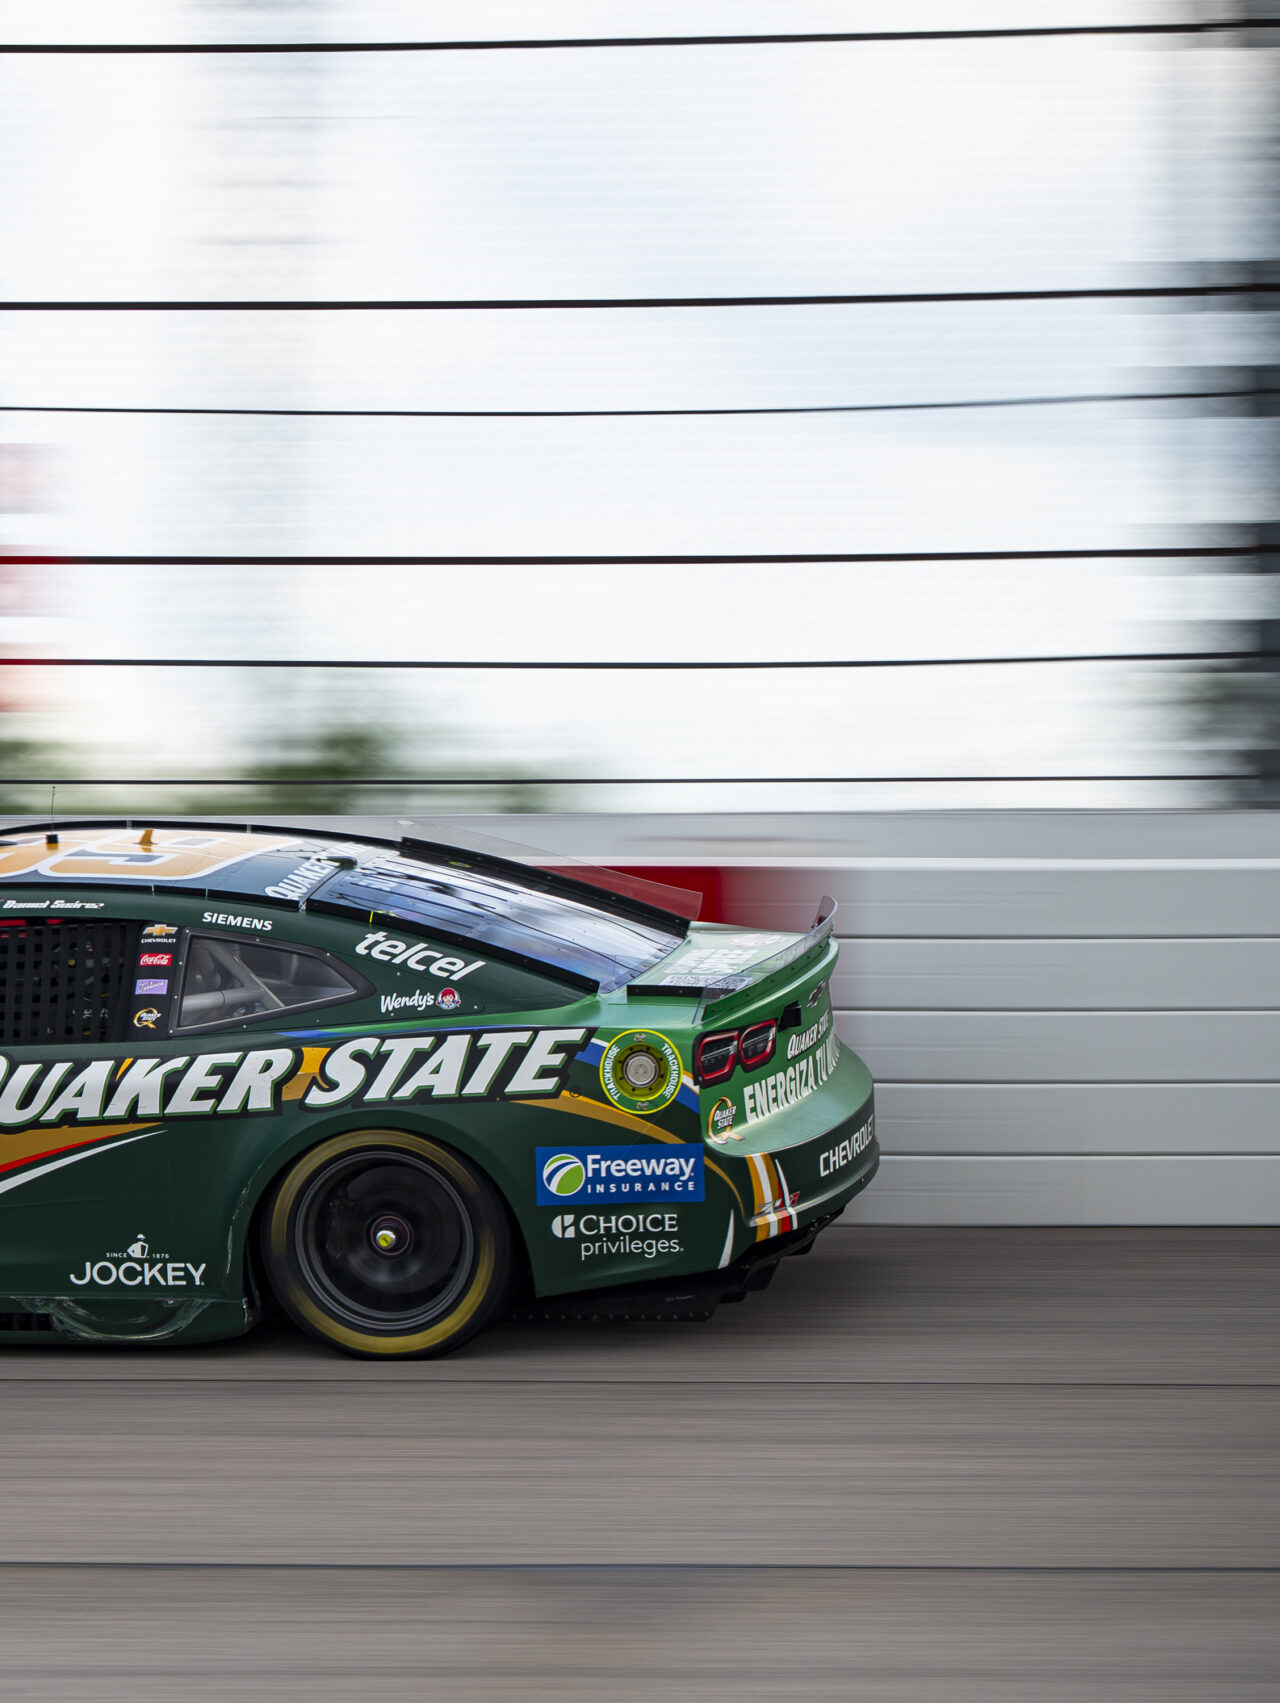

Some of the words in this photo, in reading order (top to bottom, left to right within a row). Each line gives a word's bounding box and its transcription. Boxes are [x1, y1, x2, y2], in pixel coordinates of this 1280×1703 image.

[2, 900, 49, 909] Daniel
[202, 911, 273, 931] SIEMENS
[354, 931, 486, 981] telcel
[380, 990, 435, 1013] Wendy's
[787, 1029, 818, 1060] QUAKER
[304, 1028, 588, 1108] STATE
[604, 1044, 621, 1101] TRACKHOUSE
[660, 1042, 679, 1099] TRACKHOUSE
[743, 1054, 818, 1124] ENERGIZA
[816, 1042, 828, 1086] TU
[714, 1105, 737, 1122] QUAKER
[717, 1115, 734, 1130] STATE
[587, 1154, 696, 1181] Freeway
[587, 1181, 695, 1194] INSURANCE
[579, 1214, 679, 1235] CHOICE
[69, 1261, 207, 1286] JOCKEY
